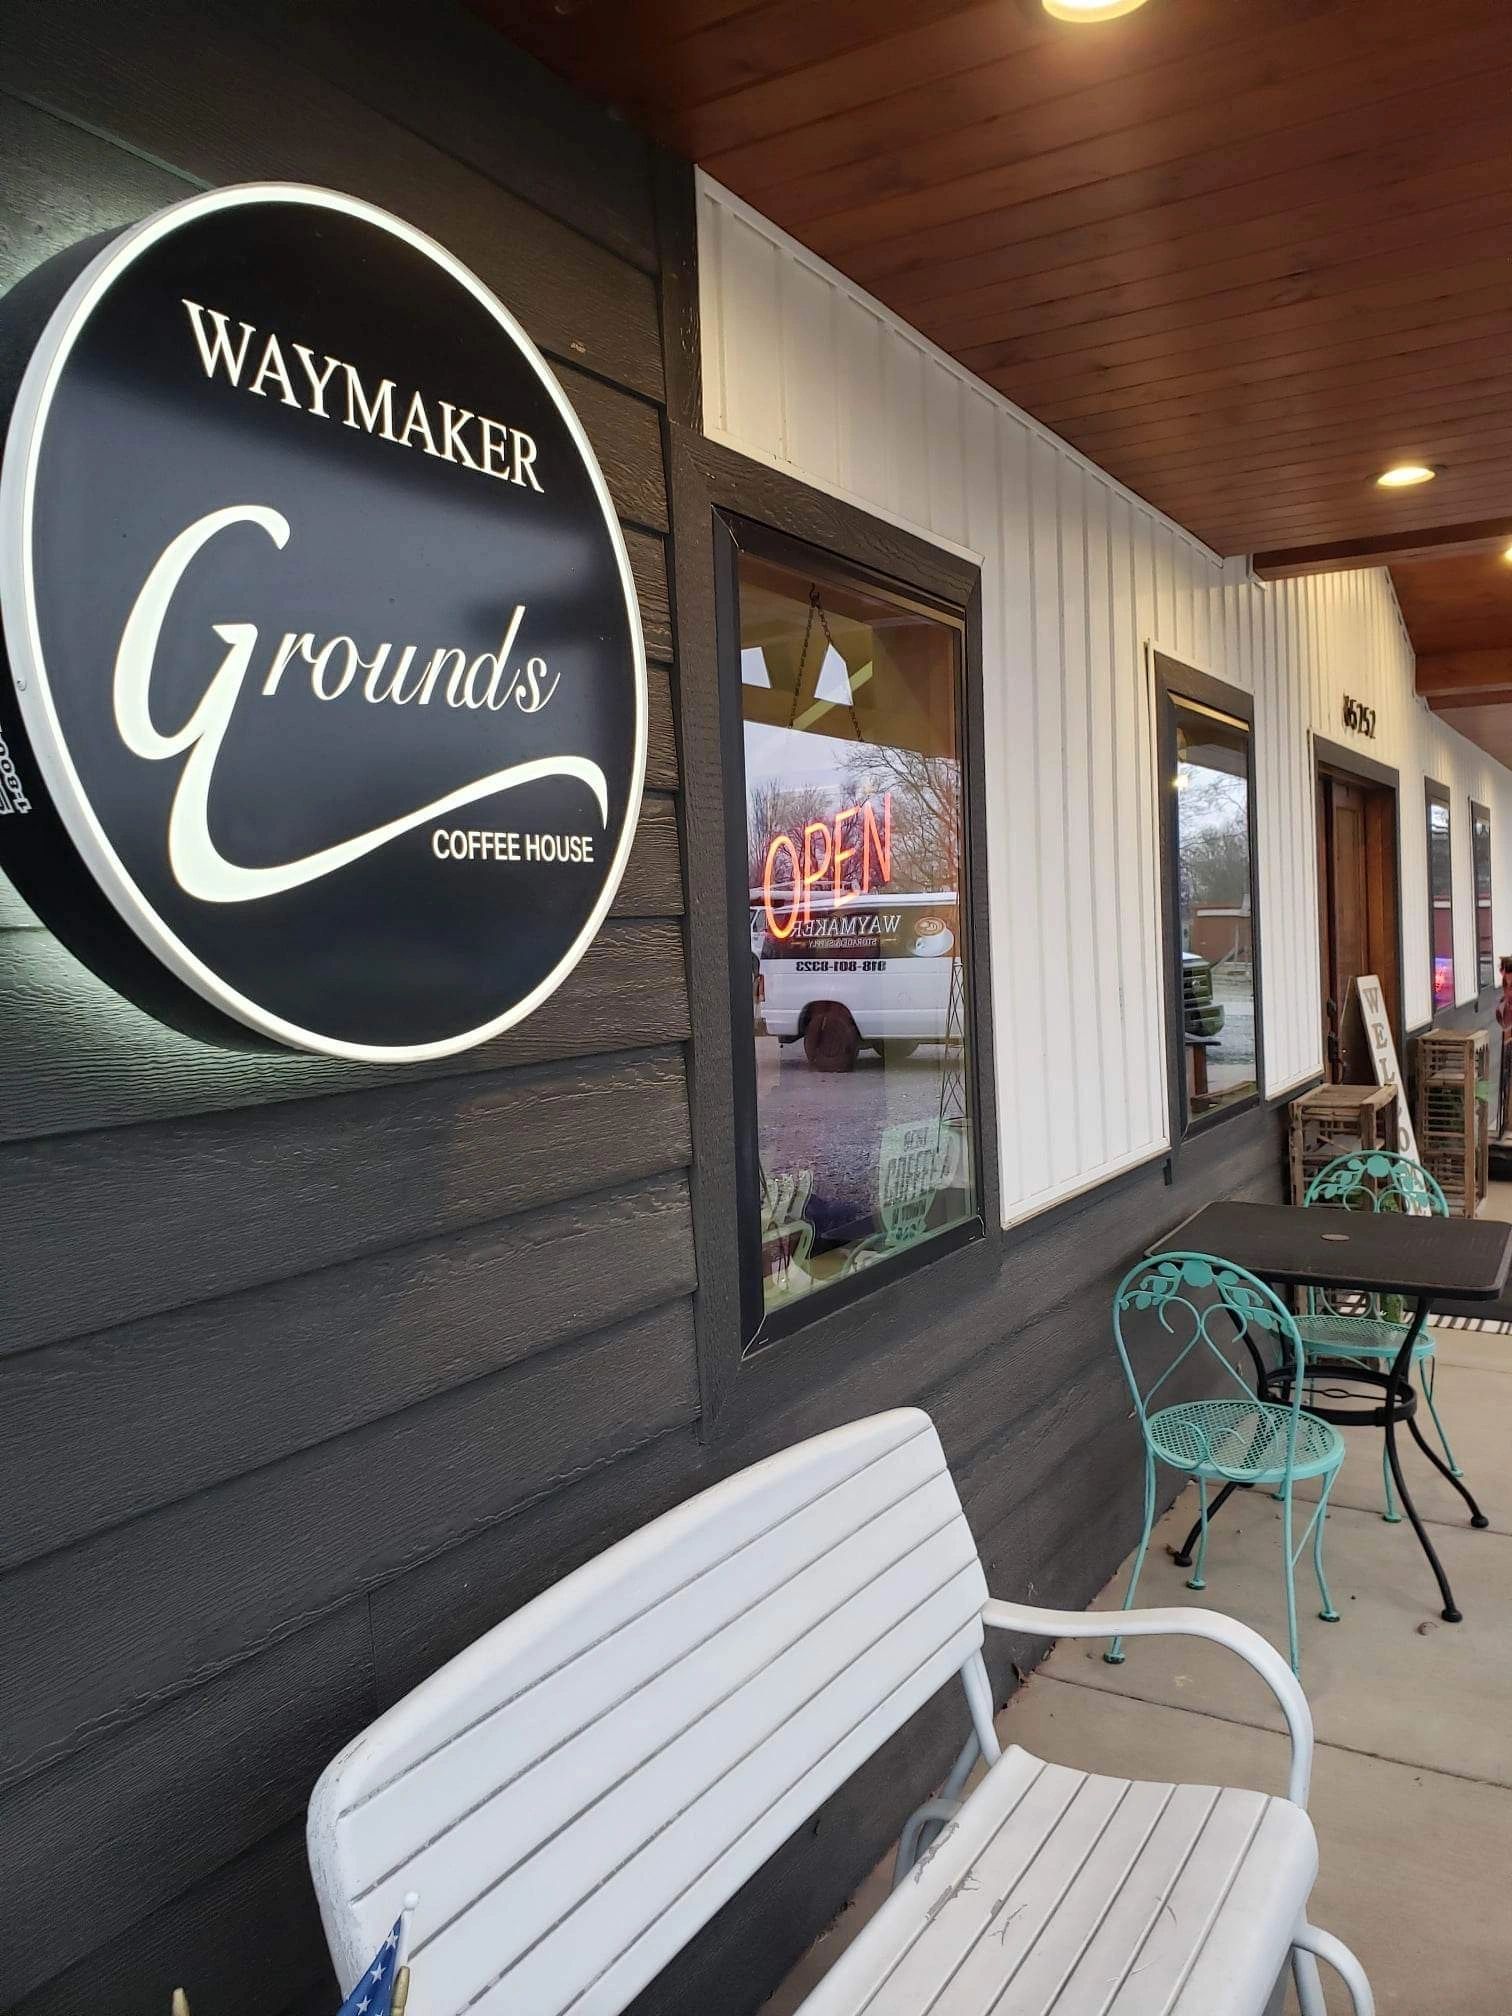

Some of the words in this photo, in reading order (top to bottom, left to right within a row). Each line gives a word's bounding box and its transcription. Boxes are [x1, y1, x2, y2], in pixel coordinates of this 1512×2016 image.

[181, 298, 546, 494] WAYMAKER
[114, 504, 608, 904] Grounds
[432, 828, 522, 863] COFFEE
[526, 832, 595, 865] HOUSE
[763, 791, 893, 939] OPEN
